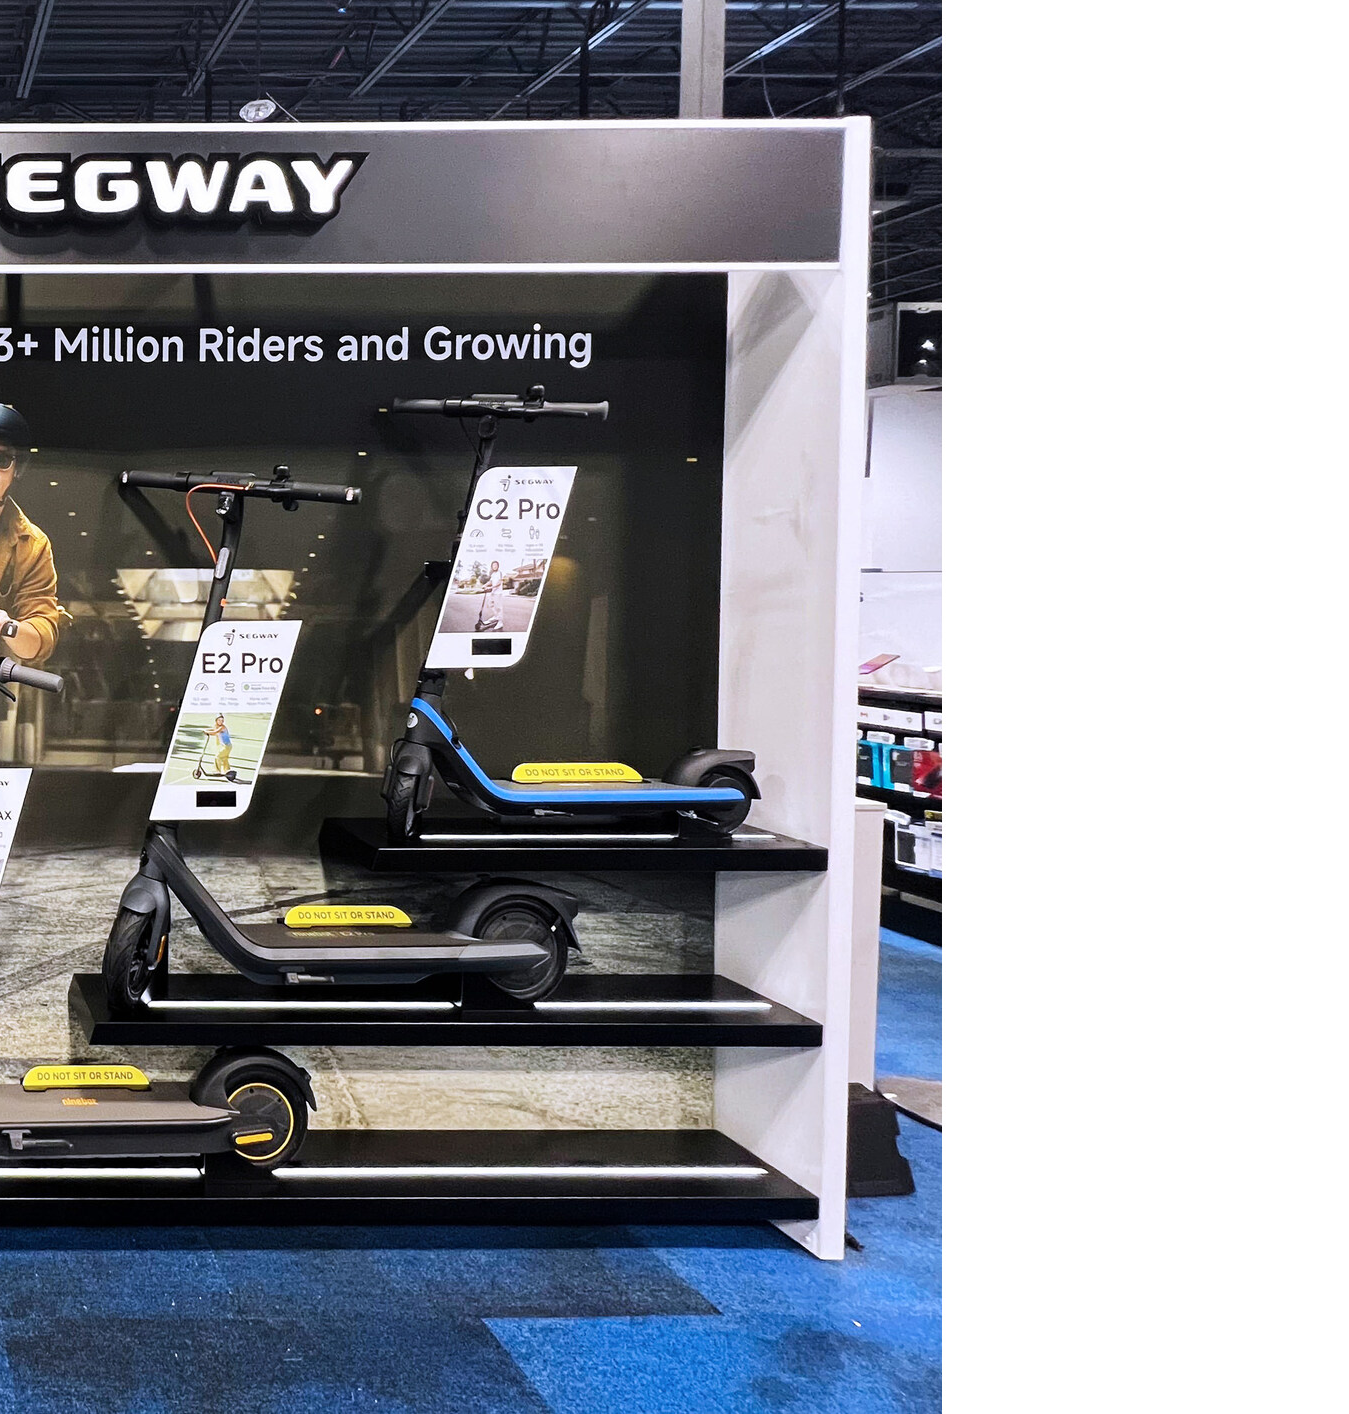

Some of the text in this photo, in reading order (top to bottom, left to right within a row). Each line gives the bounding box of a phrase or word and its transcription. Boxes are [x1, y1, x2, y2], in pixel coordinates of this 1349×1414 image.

[53, 325, 183, 363] Million
[199, 326, 323, 363] Riders
[337, 326, 410, 362] and
[423, 324, 593, 369] Growing
[476, 498, 561, 520] C2 Pro
[202, 652, 284, 674] E2 Pro
[525, 769, 624, 777] DO NOT SIT OR STAND
[298, 911, 395, 920] DO NOT SIT OR STAND
[37, 1072, 134, 1081] DO NOT SIT OR STAND
